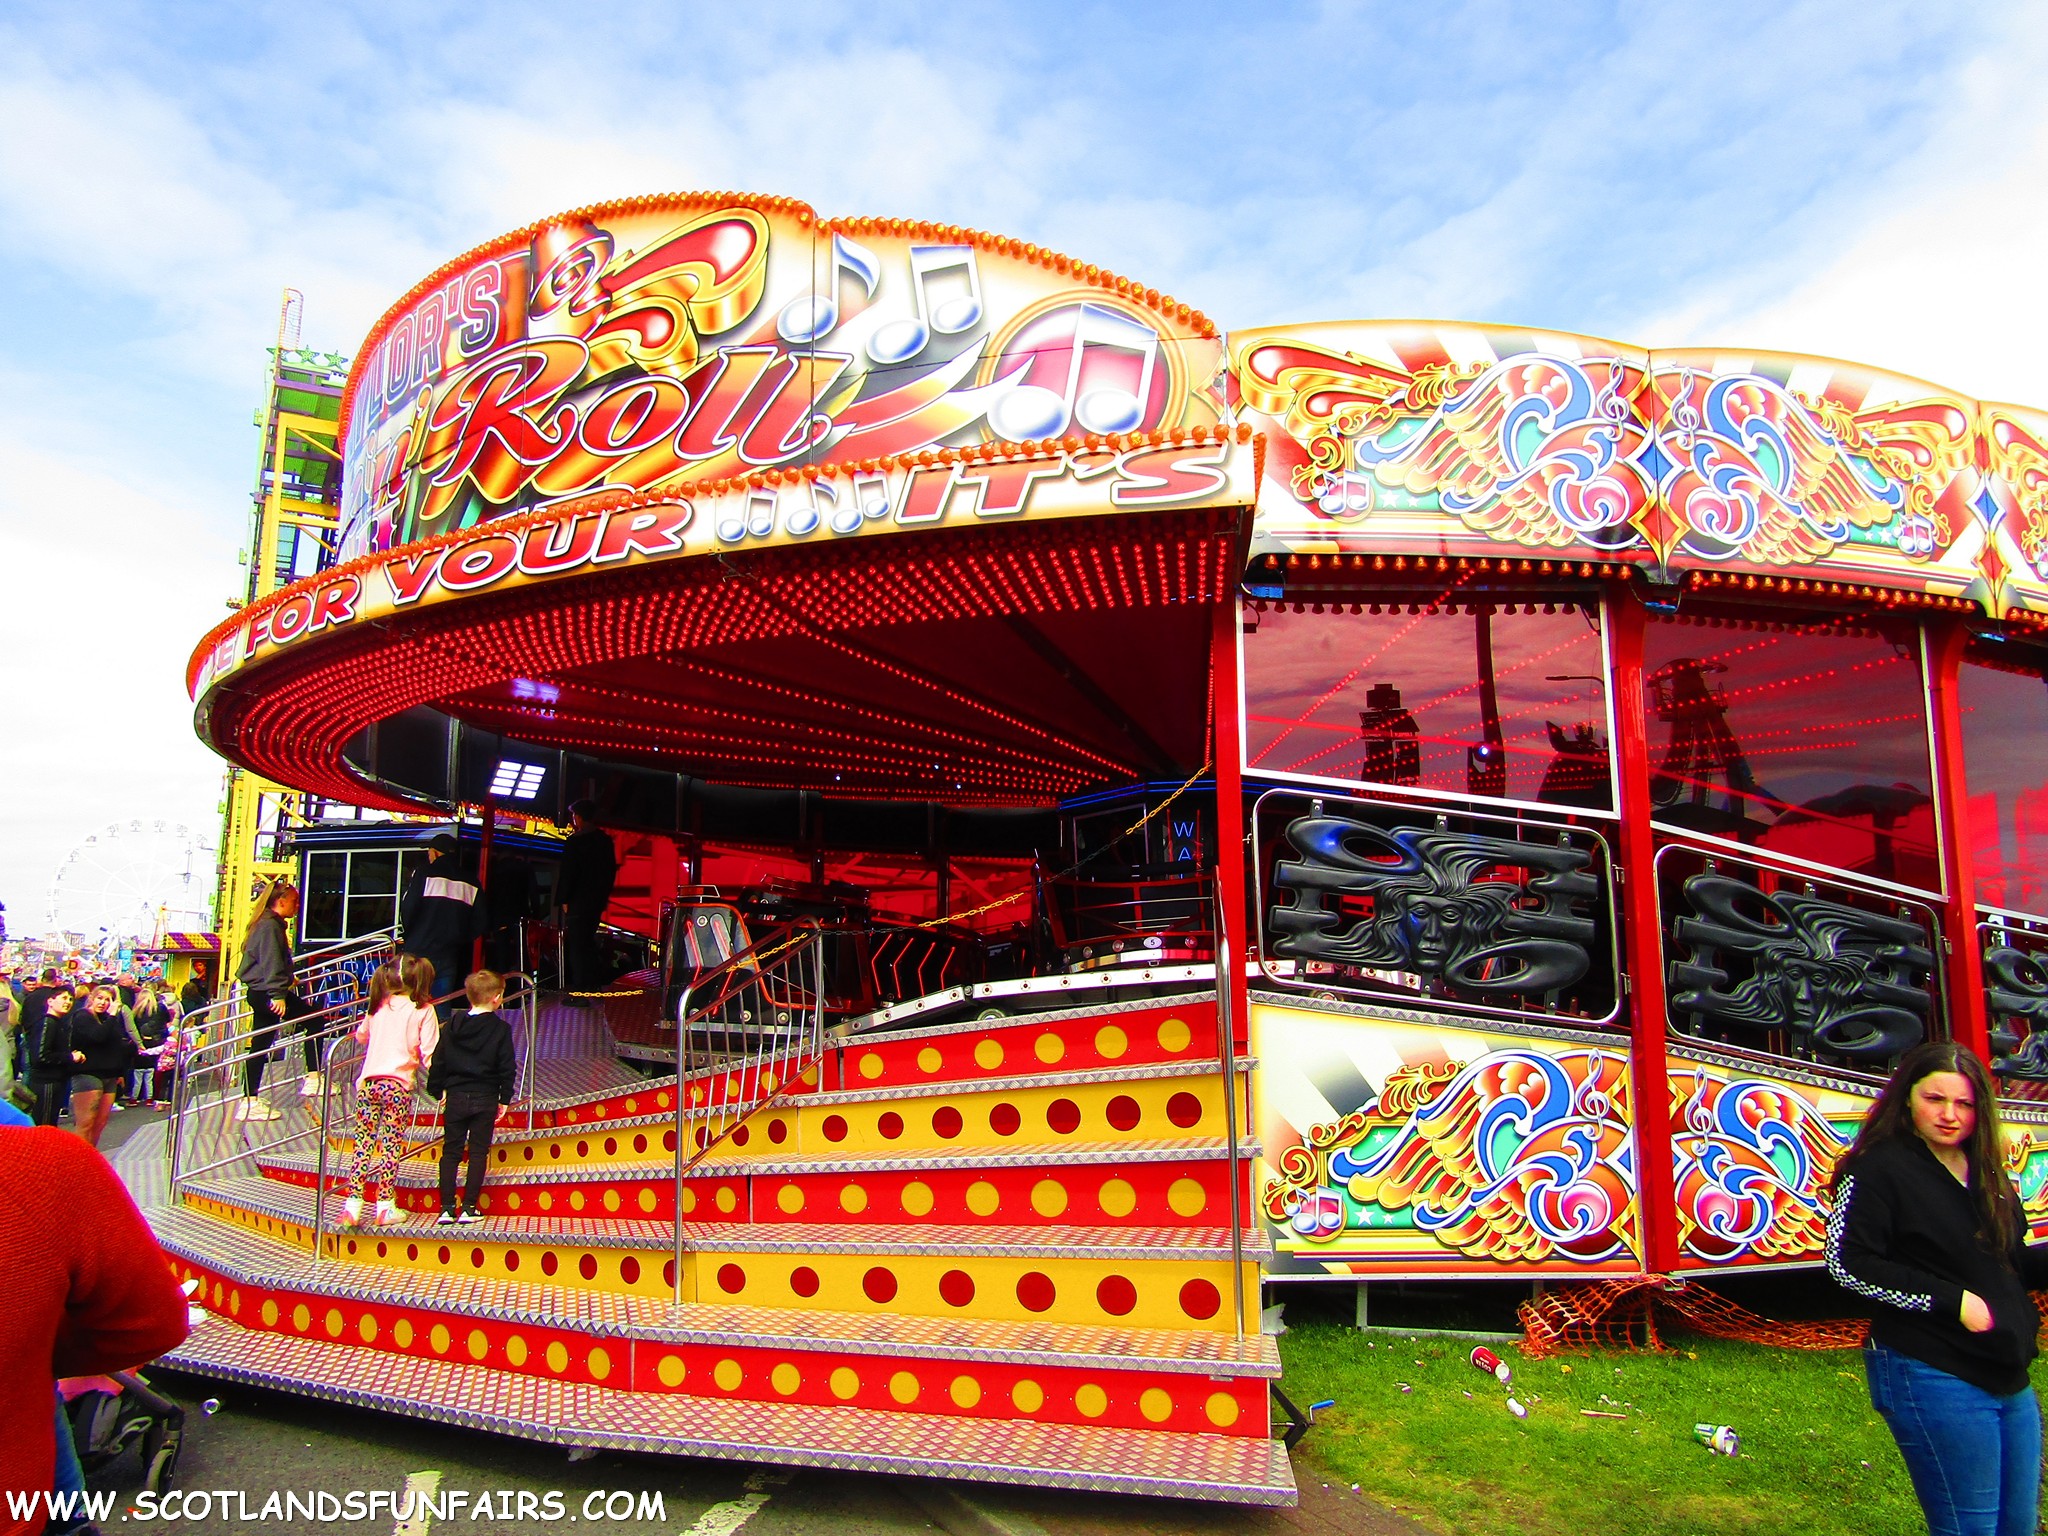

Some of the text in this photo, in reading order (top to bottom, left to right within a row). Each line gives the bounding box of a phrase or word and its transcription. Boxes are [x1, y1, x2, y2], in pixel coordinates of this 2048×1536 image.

[430, 335, 854, 488] Roll
[244, 573, 361, 660] FOR
[383, 498, 693, 606] YOUR
[893, 438, 1229, 524] IT'S
[1173, 821, 1195, 879] WA
